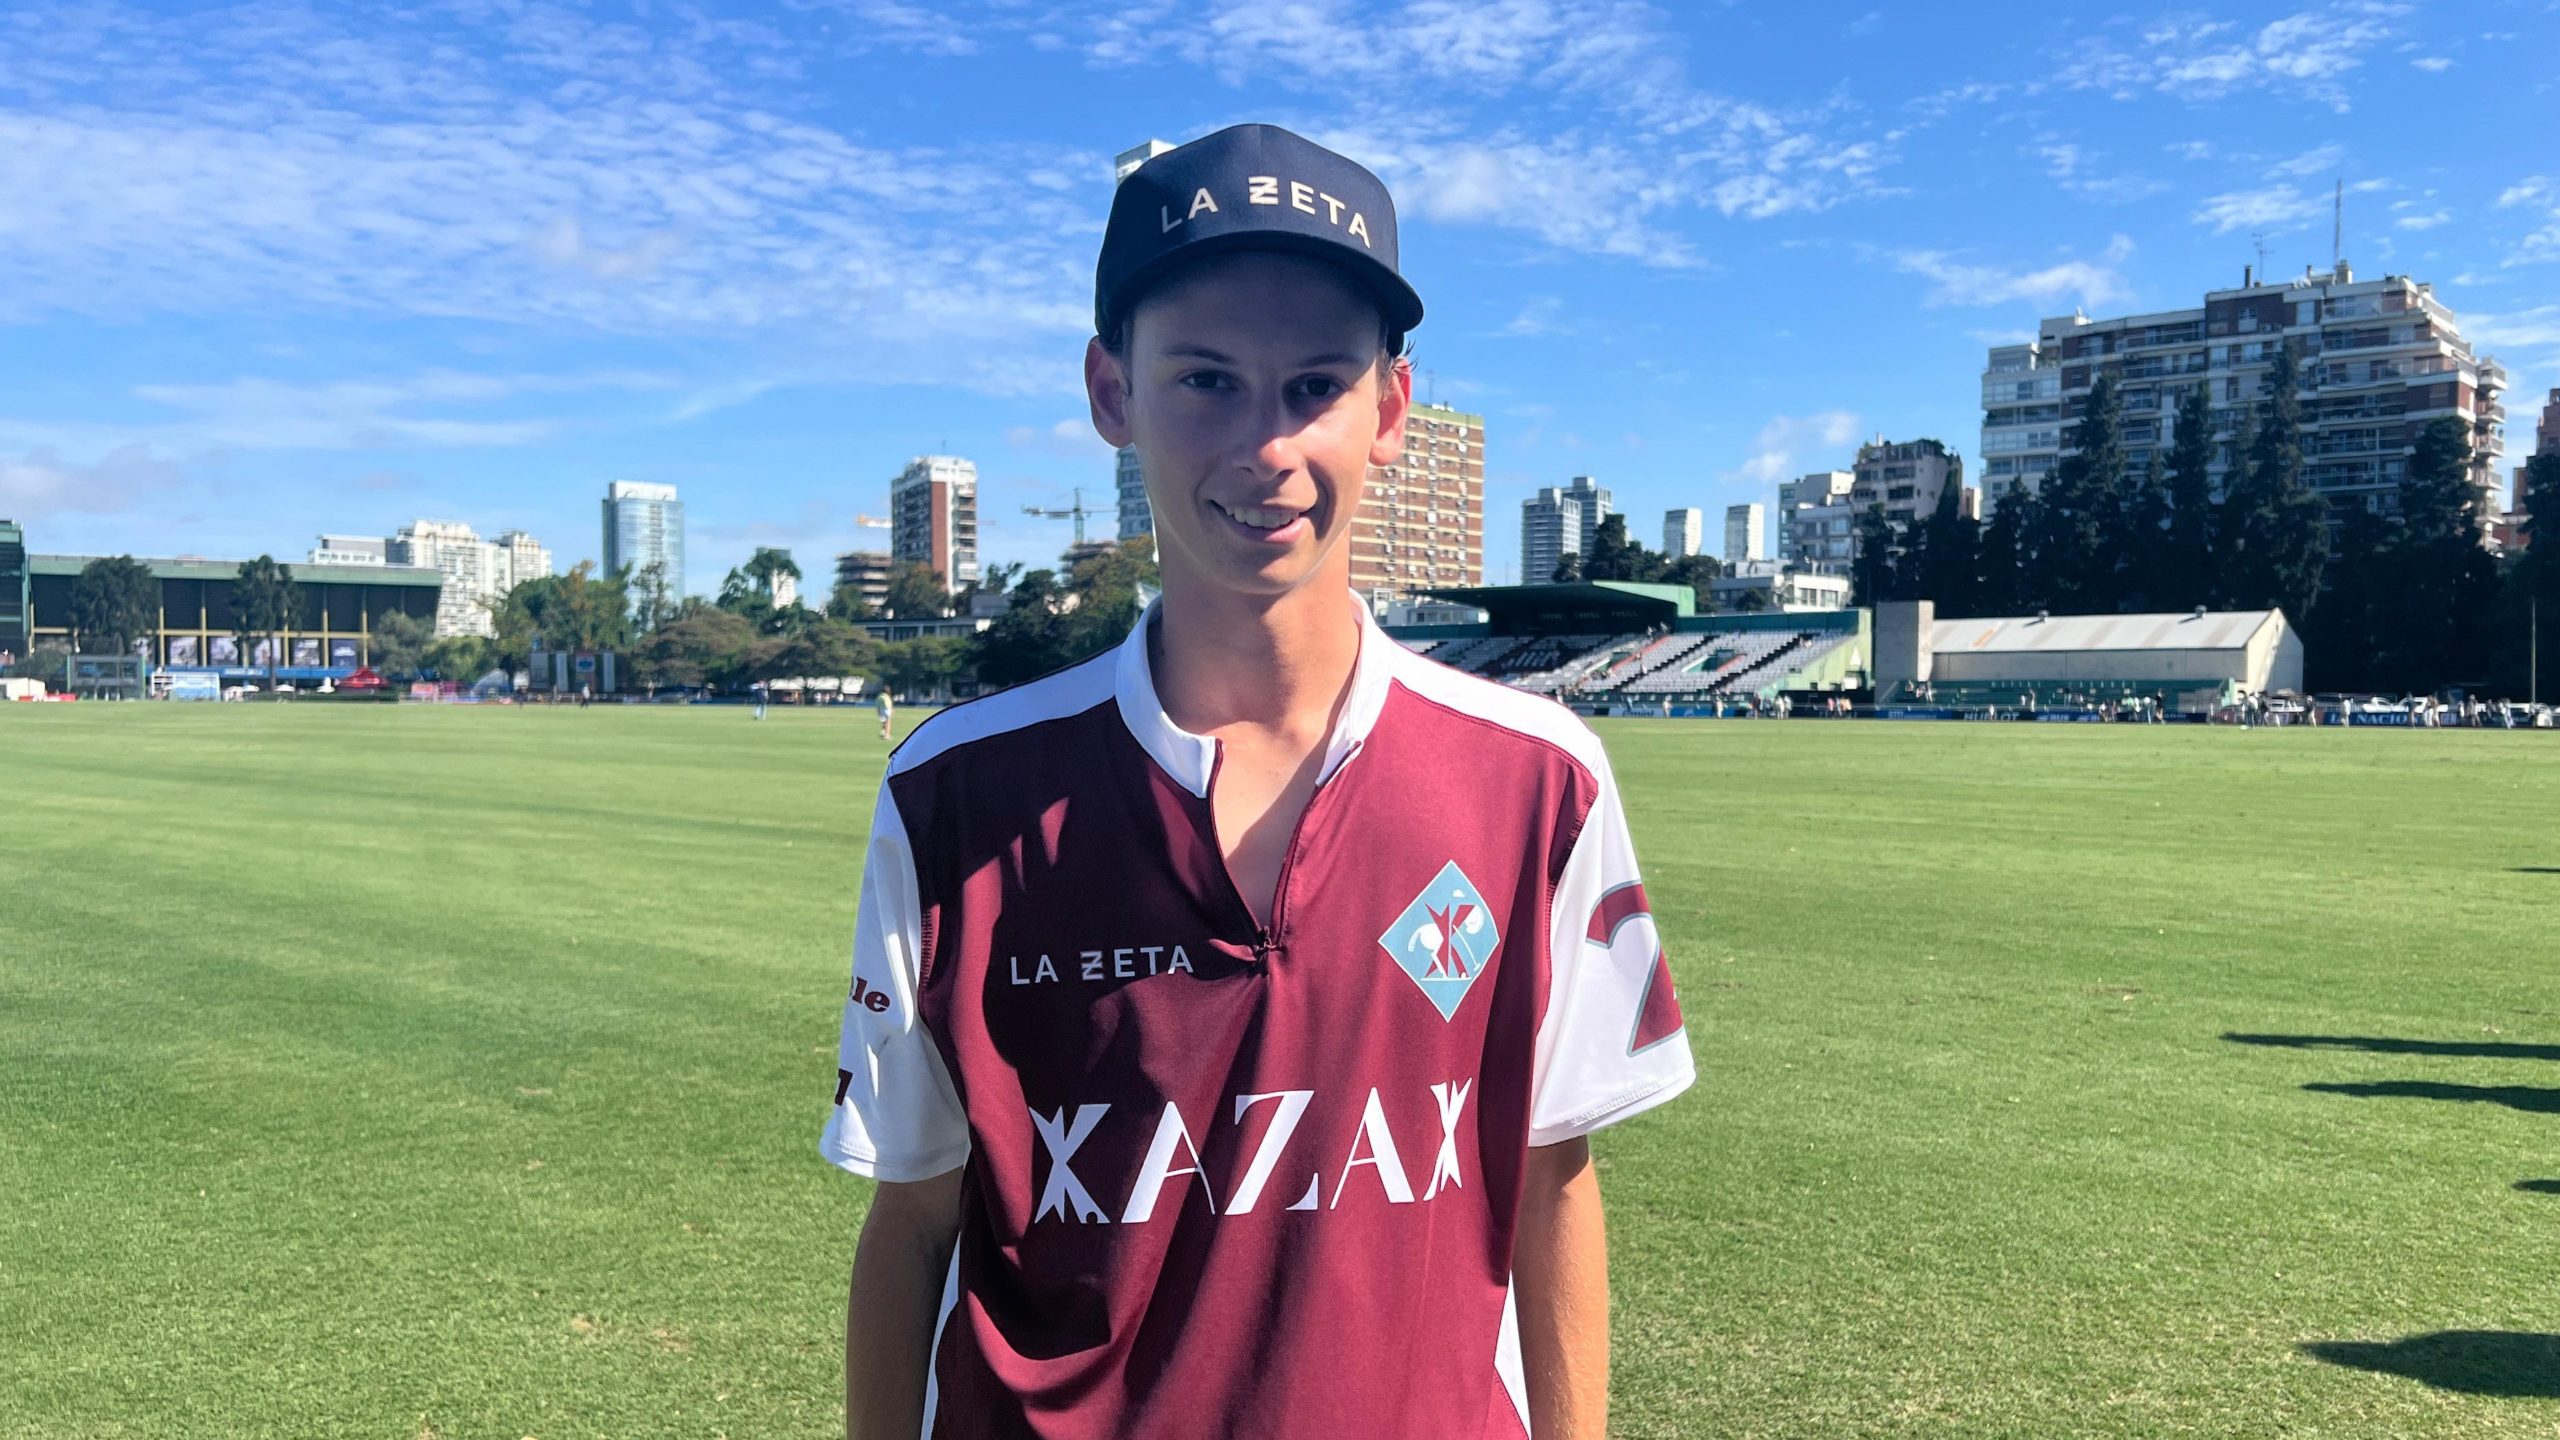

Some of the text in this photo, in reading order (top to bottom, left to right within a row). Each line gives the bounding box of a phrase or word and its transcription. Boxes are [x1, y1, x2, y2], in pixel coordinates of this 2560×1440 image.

[1161, 175, 1371, 249] LA ZETA
[2357, 713, 2421, 725] NACIO
[1010, 945, 1194, 985] LA ZETA
[849, 975, 890, 1013] le
